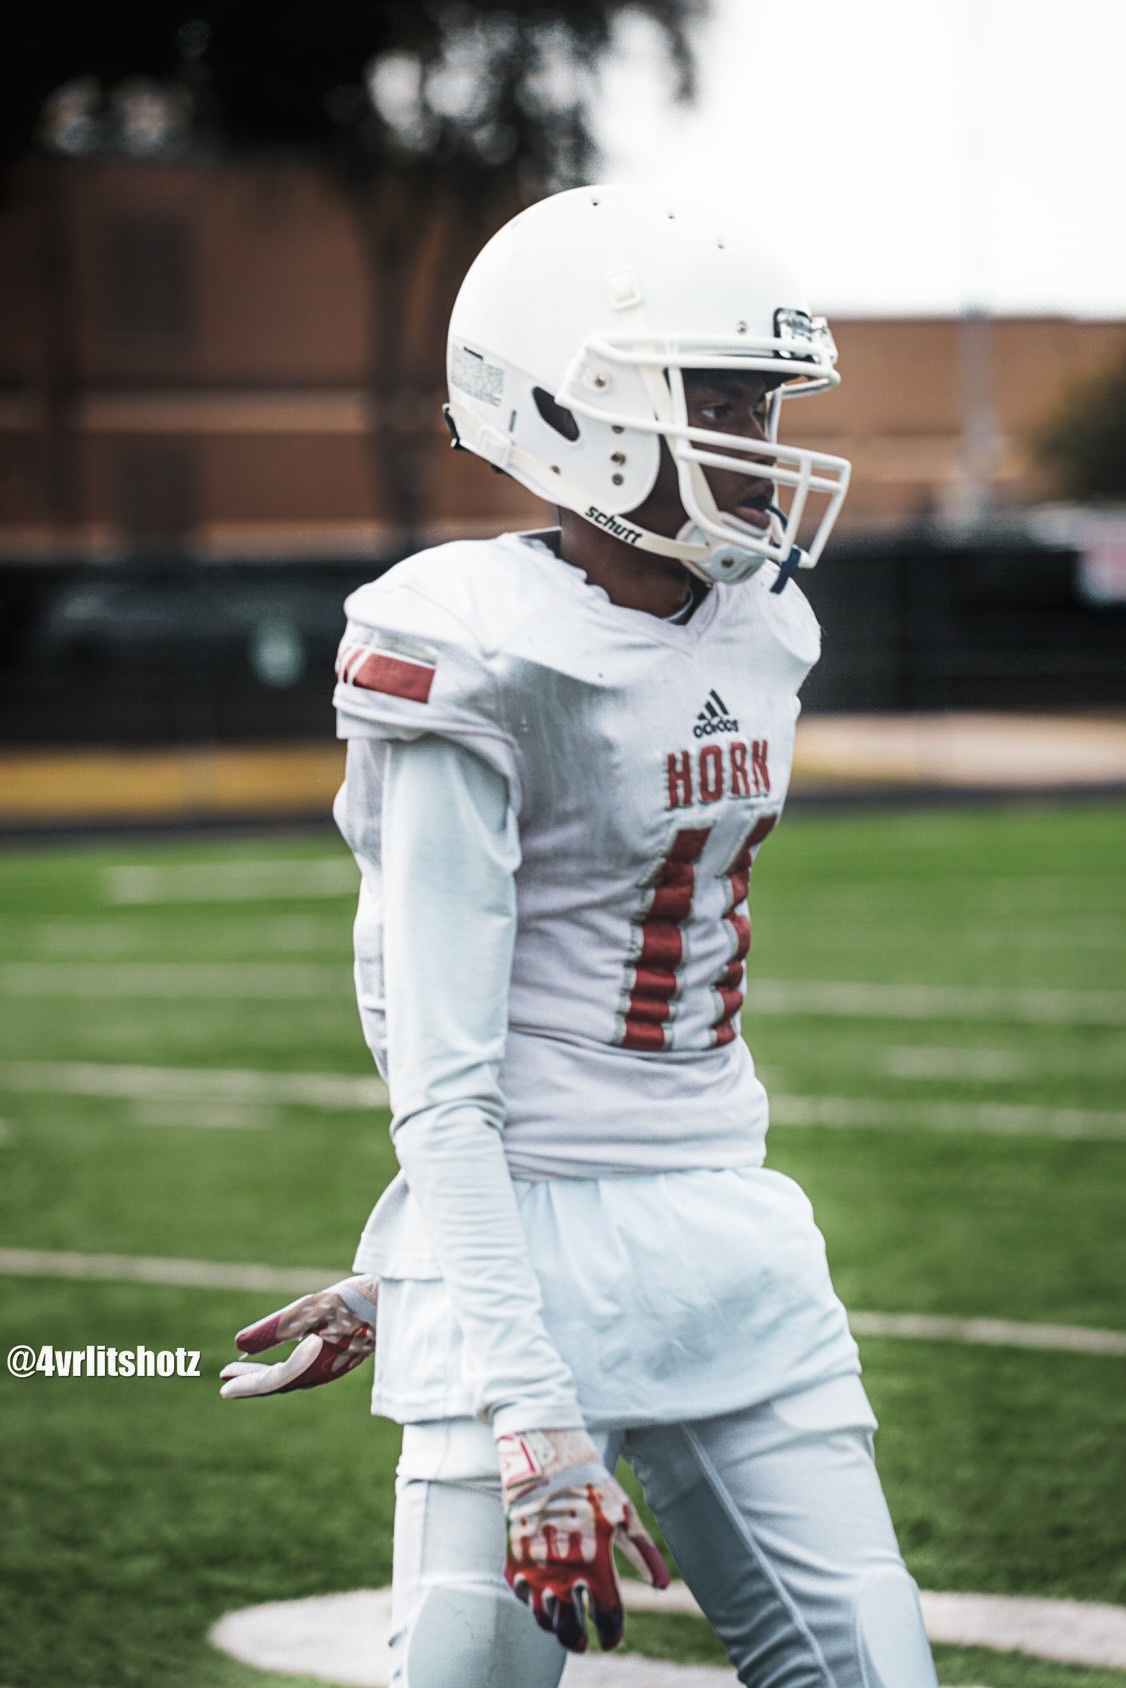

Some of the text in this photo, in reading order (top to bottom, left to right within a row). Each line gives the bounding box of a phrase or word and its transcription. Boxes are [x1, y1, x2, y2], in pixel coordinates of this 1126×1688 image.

[585, 506, 642, 544] schutt
[693, 717, 739, 739] adidas
[664, 739, 770, 810] HORN
[616, 813, 779, 1052] 11
